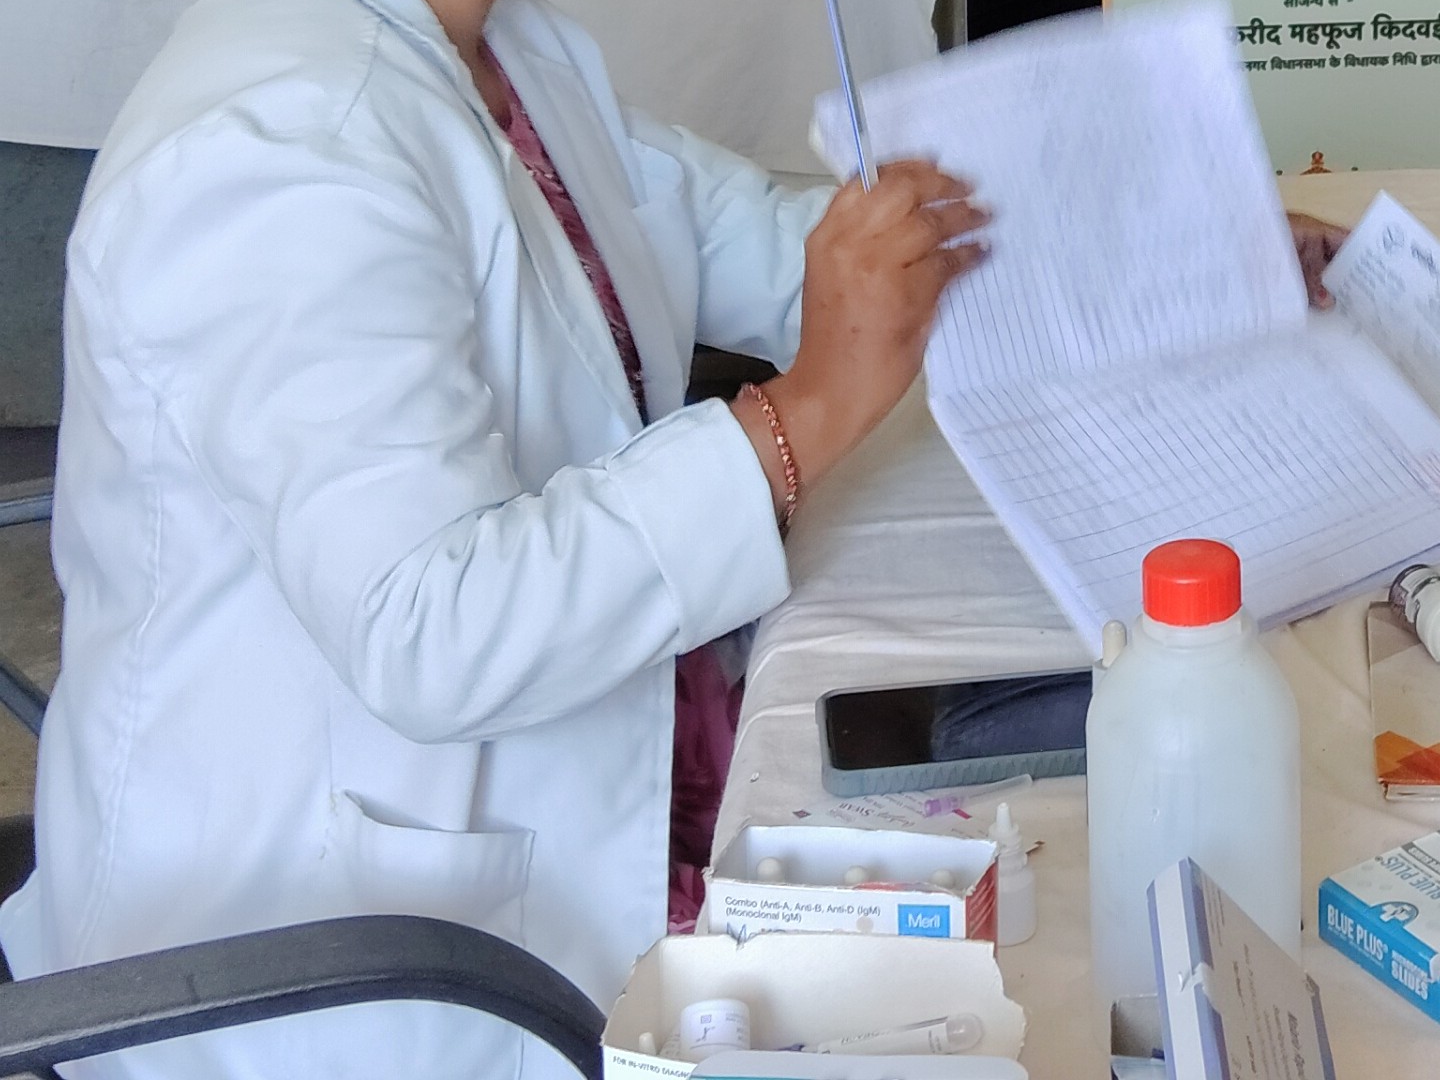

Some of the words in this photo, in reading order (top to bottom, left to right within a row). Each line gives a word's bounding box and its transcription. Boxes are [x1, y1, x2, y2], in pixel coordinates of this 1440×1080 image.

[1288, 21, 1365, 50] महफूज
[1271, 55, 1325, 70] विधानसभा
[1329, 54, 1340, 67] के
[1343, 53, 1389, 67] विधायक
[1392, 51, 1417, 66] निधि
[725, 896, 757, 908] Combo
[760, 899, 791, 912] (Anti-A,
[794, 902, 824, 914] Anti-B,
[827, 904, 854, 914] Anti-D
[857, 905, 881, 917] (IgM)
[725, 908, 780, 921] (Monoclonal
[782, 911, 802, 923] IgM)
[907, 912, 941, 929] Meril
[1328, 904, 1354, 940] BLUE
[1391, 959, 1428, 1001] SLIDES
